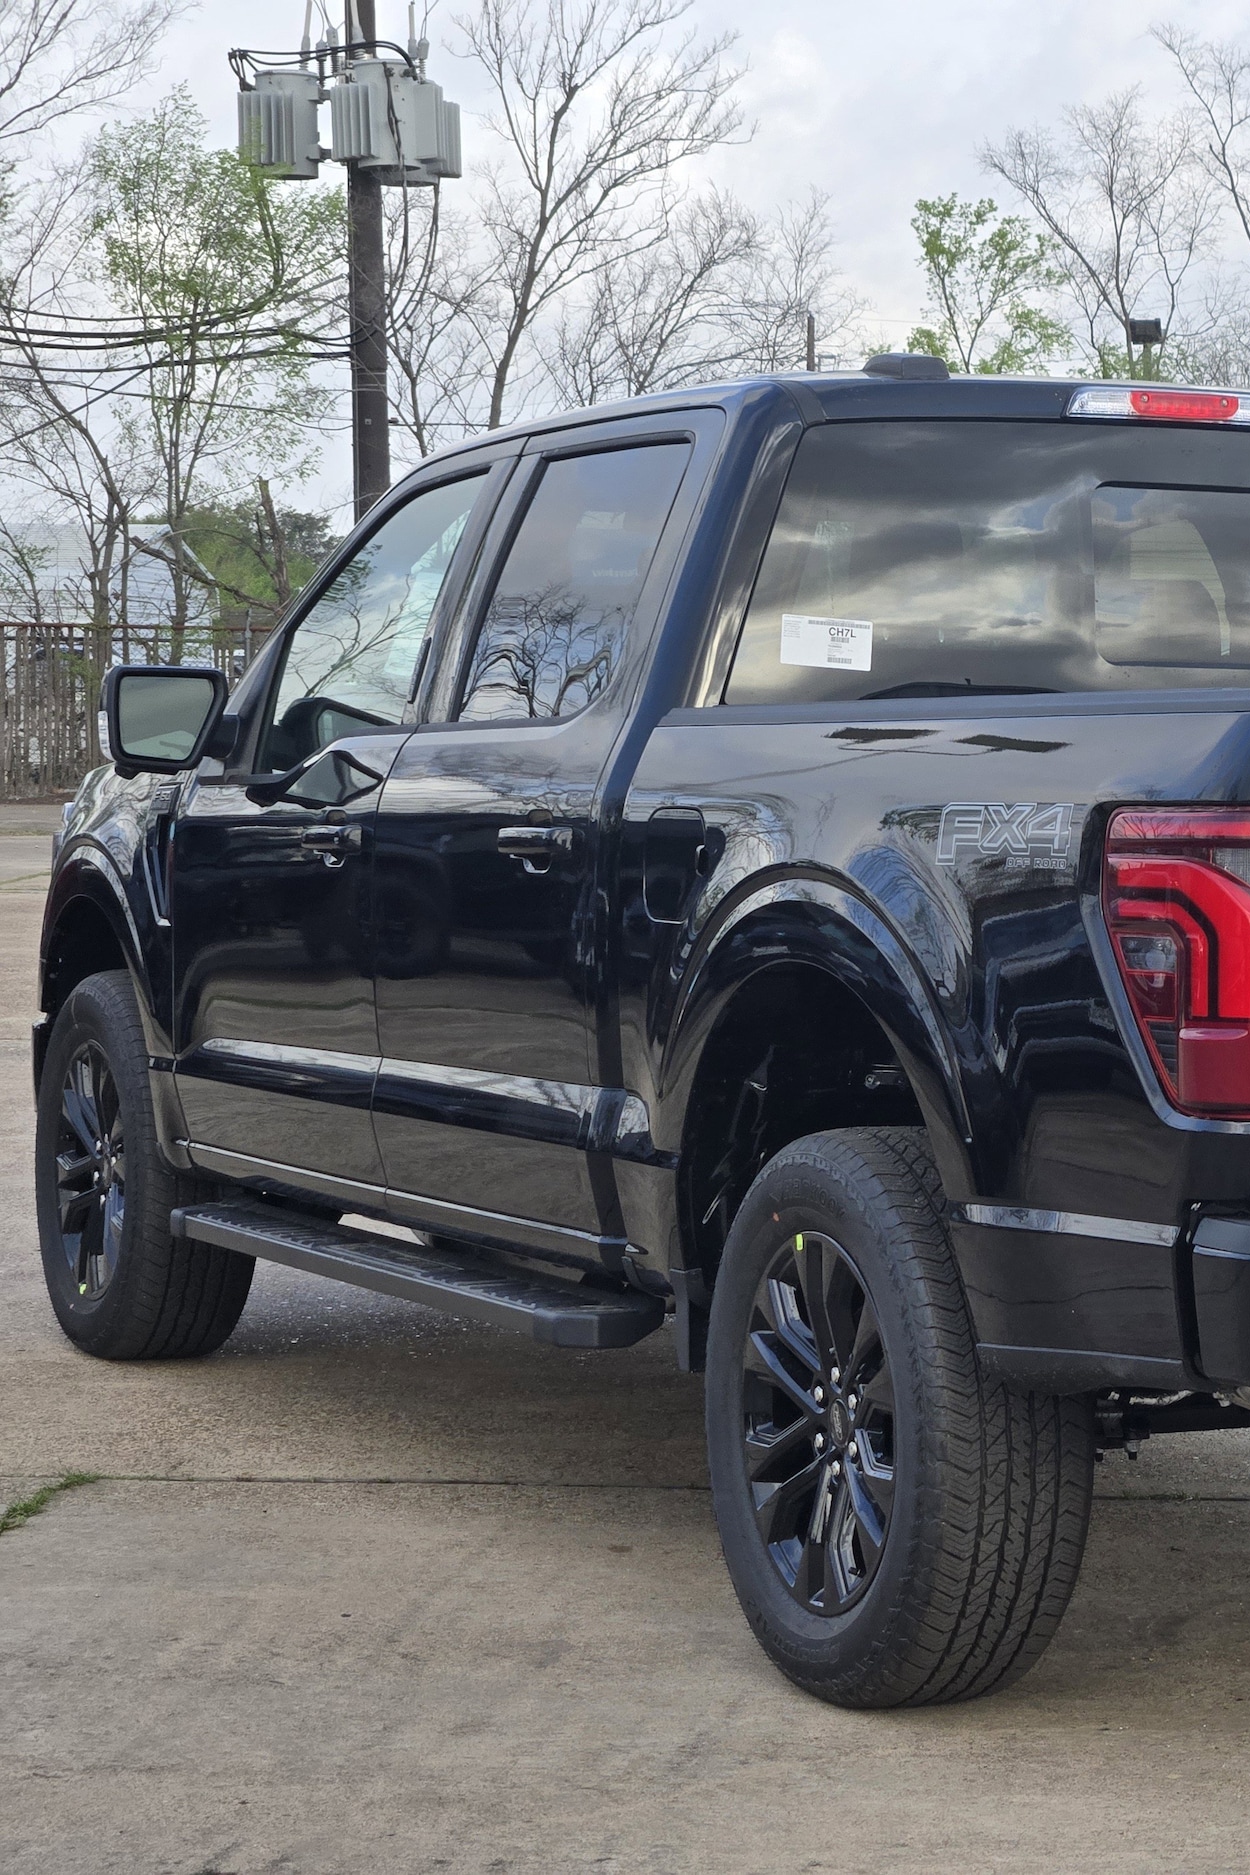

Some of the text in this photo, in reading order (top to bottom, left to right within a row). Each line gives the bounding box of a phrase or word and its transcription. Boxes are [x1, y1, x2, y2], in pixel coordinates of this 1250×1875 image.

[828, 626, 857, 639] CH7L
[935, 801, 1075, 865] FX4
[1006, 856, 1067, 870] OFF ROAD
